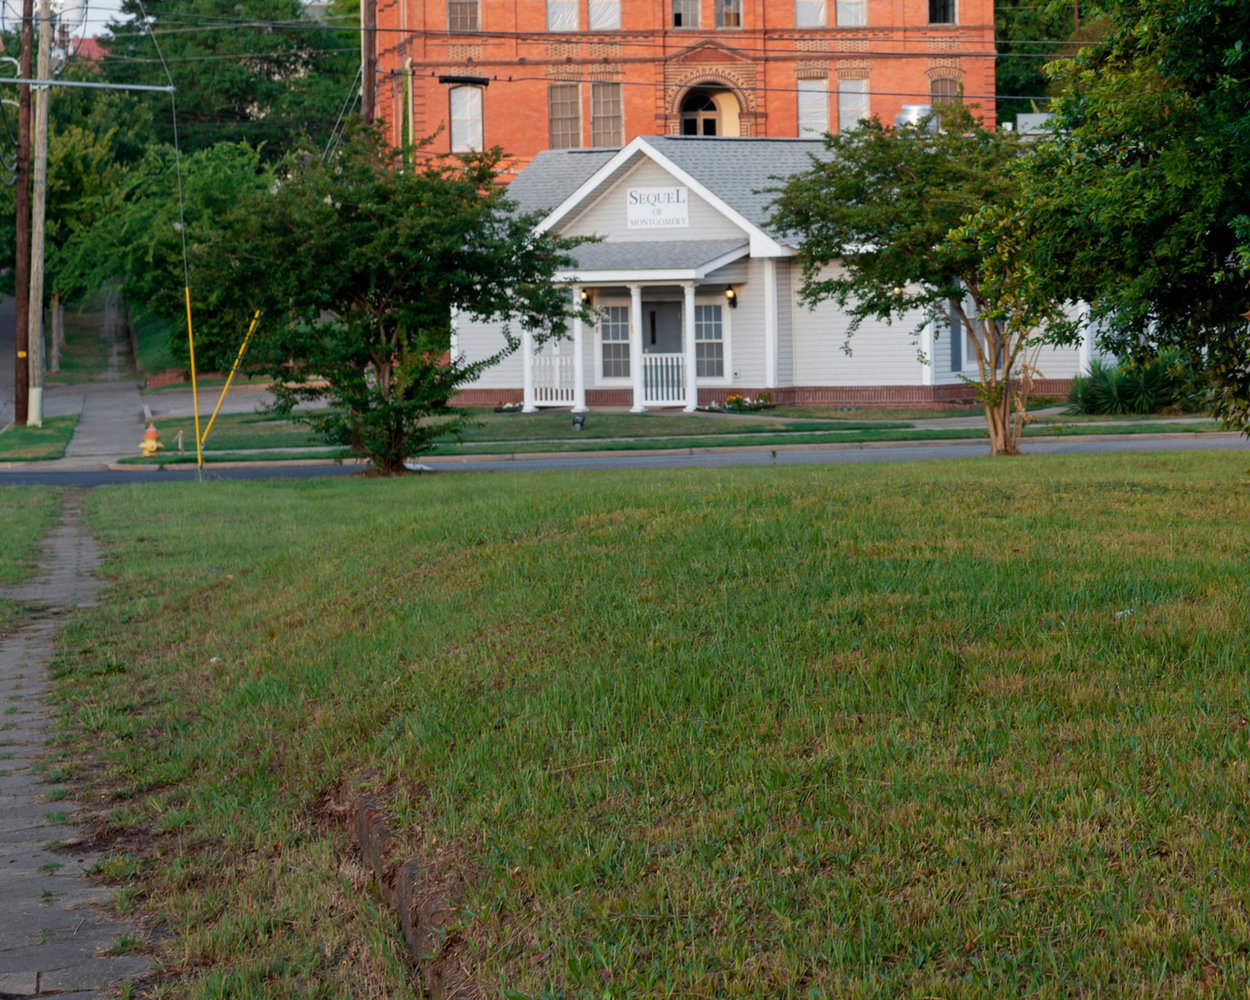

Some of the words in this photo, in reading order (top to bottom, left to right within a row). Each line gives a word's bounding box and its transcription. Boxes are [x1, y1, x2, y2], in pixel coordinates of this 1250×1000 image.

[629, 189, 686, 206] SEQUEL
[652, 208, 662, 216] OF
[630, 218, 686, 226] MONTGOMERY
